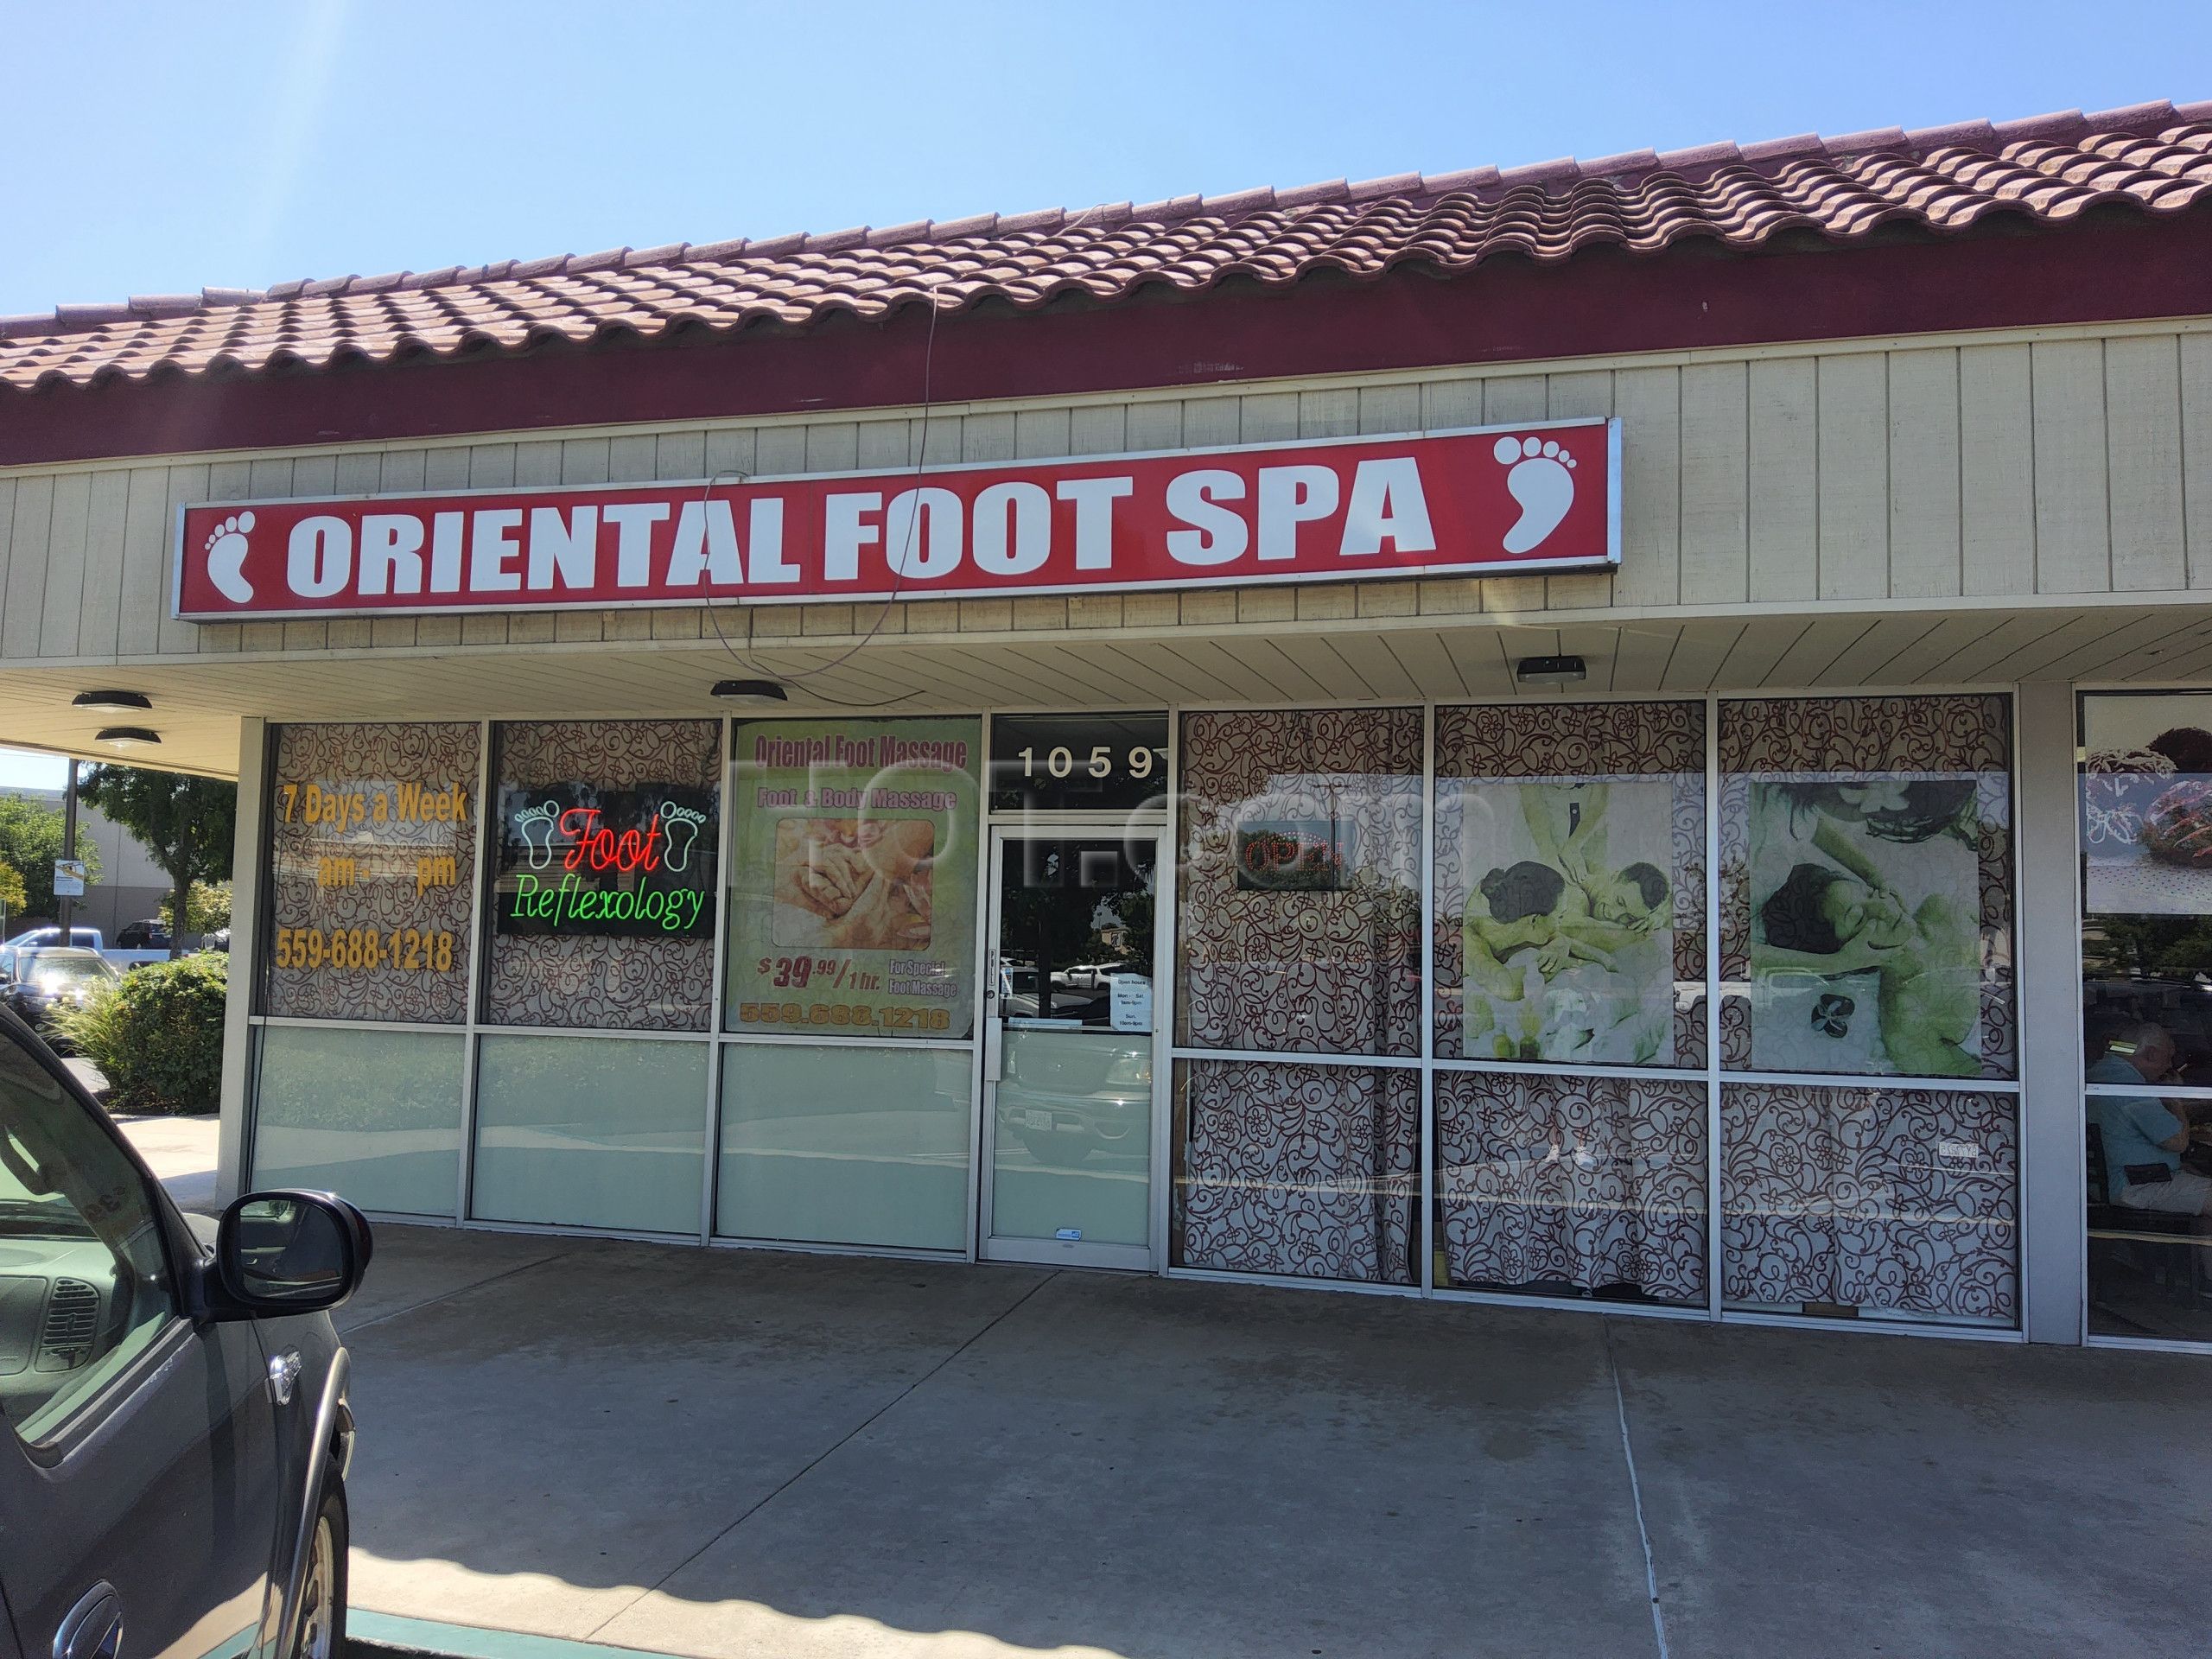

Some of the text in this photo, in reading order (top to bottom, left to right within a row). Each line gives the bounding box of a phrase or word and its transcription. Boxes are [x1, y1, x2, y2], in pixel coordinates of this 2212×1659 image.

[287, 456, 1436, 598] ORIENTAL FOOT SPA
[755, 734, 968, 772] Oriental Foot Massage
[1018, 746, 1153, 779] 1059
[283, 781, 467, 833] 7 Days a Week
[757, 787, 957, 811] Foot & Body Massage
[559, 808, 662, 871] Foot
[1245, 841, 1344, 871] OPEN
[318, 856, 355, 887] am
[417, 856, 456, 897] pm
[510, 874, 705, 930] Reflexology
[276, 929, 454, 971] 559-688-1218
[889, 958, 946, 977] For Special
[888, 978, 957, 999] Foot Massage
[740, 1002, 951, 1031] 559.688.1218
